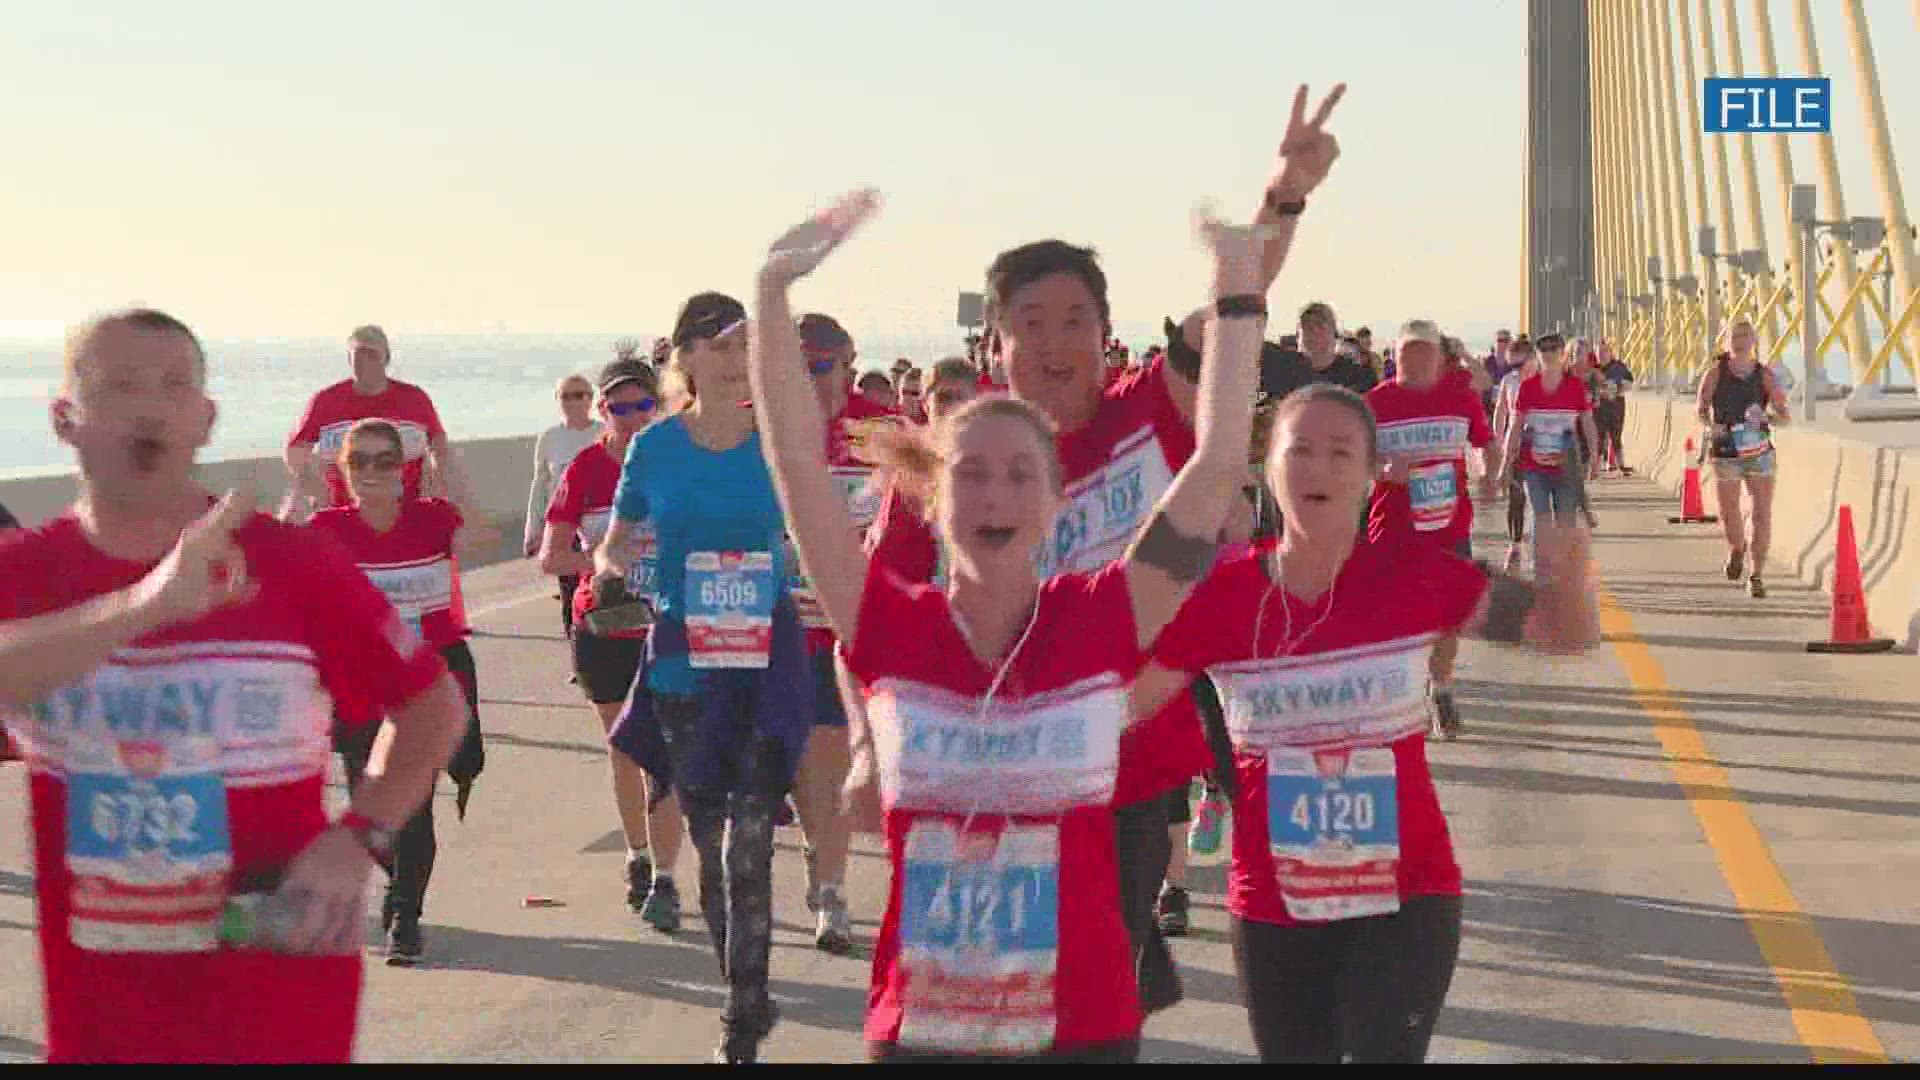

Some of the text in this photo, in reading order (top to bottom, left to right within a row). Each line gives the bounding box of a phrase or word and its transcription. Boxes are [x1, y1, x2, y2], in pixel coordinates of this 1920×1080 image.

[700, 578, 757, 605] 6509
[1289, 791, 1375, 832] 4120
[925, 872, 1027, 938] 4121
